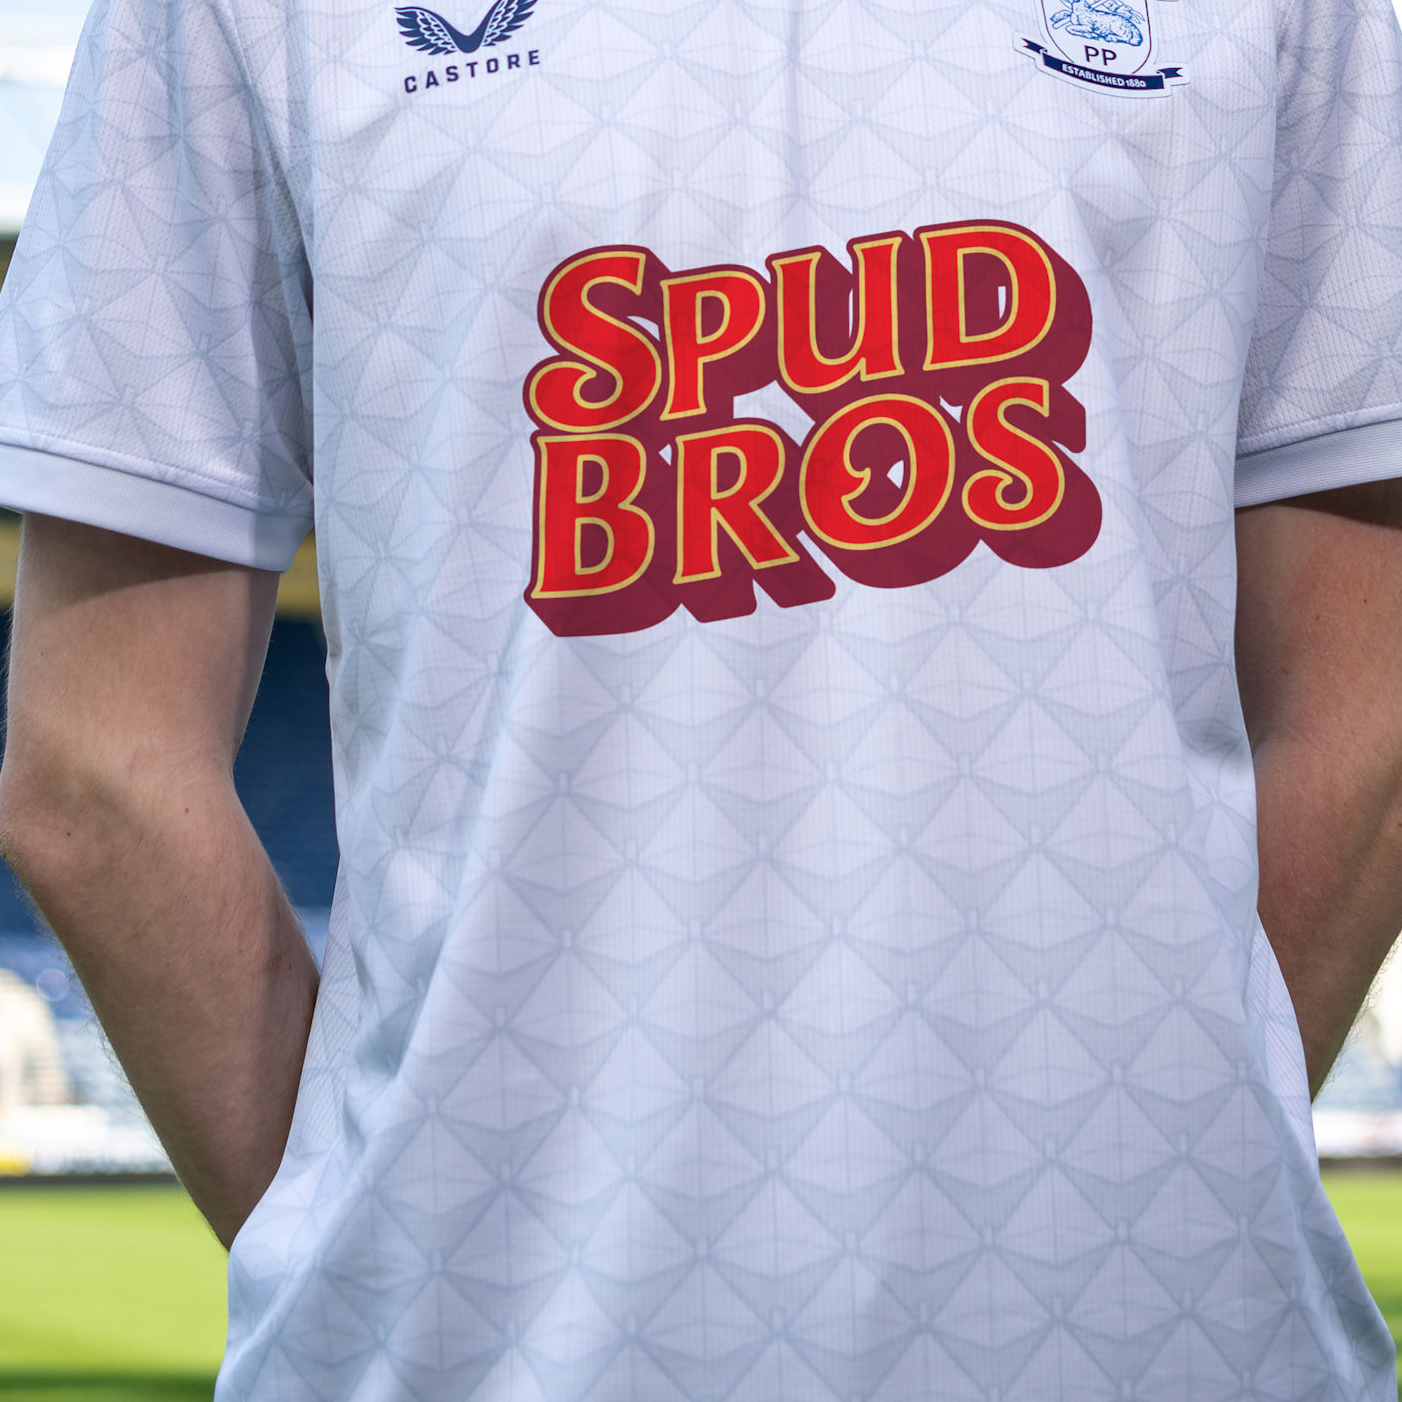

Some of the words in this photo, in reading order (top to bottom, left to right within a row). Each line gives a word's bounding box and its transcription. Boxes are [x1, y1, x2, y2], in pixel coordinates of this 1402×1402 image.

[404, 49, 541, 94] CASTORE
[1061, 63, 1125, 87] ESTABLISHED
[1125, 77, 1147, 88] 1880
[1084, 45, 1117, 66] PP
[524, 220, 1092, 433] SPUD
[526, 376, 1088, 623] BROS
